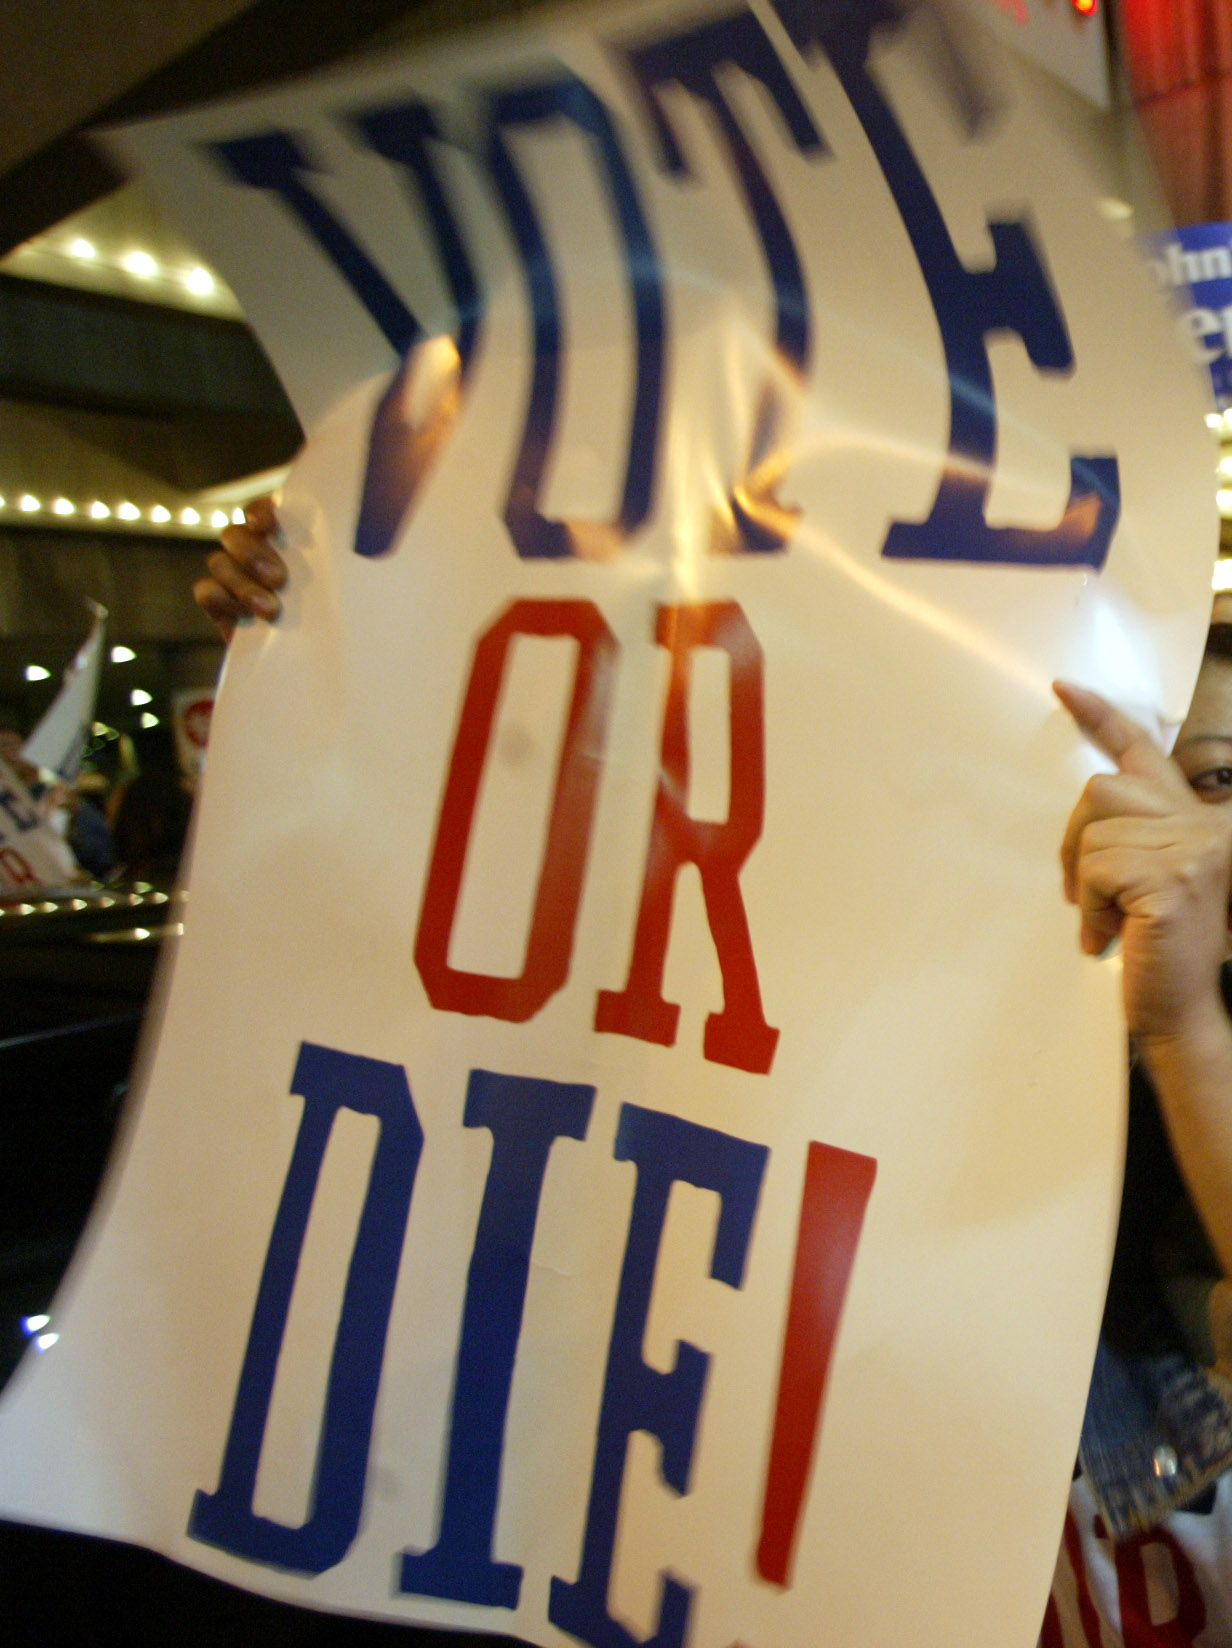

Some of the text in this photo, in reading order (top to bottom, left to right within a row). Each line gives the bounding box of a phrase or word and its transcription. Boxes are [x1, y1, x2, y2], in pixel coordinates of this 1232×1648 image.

[203, 0, 1121, 572] VOTE
[413, 596, 780, 1075] OR
[186, 1041, 878, 1648] DIE!
